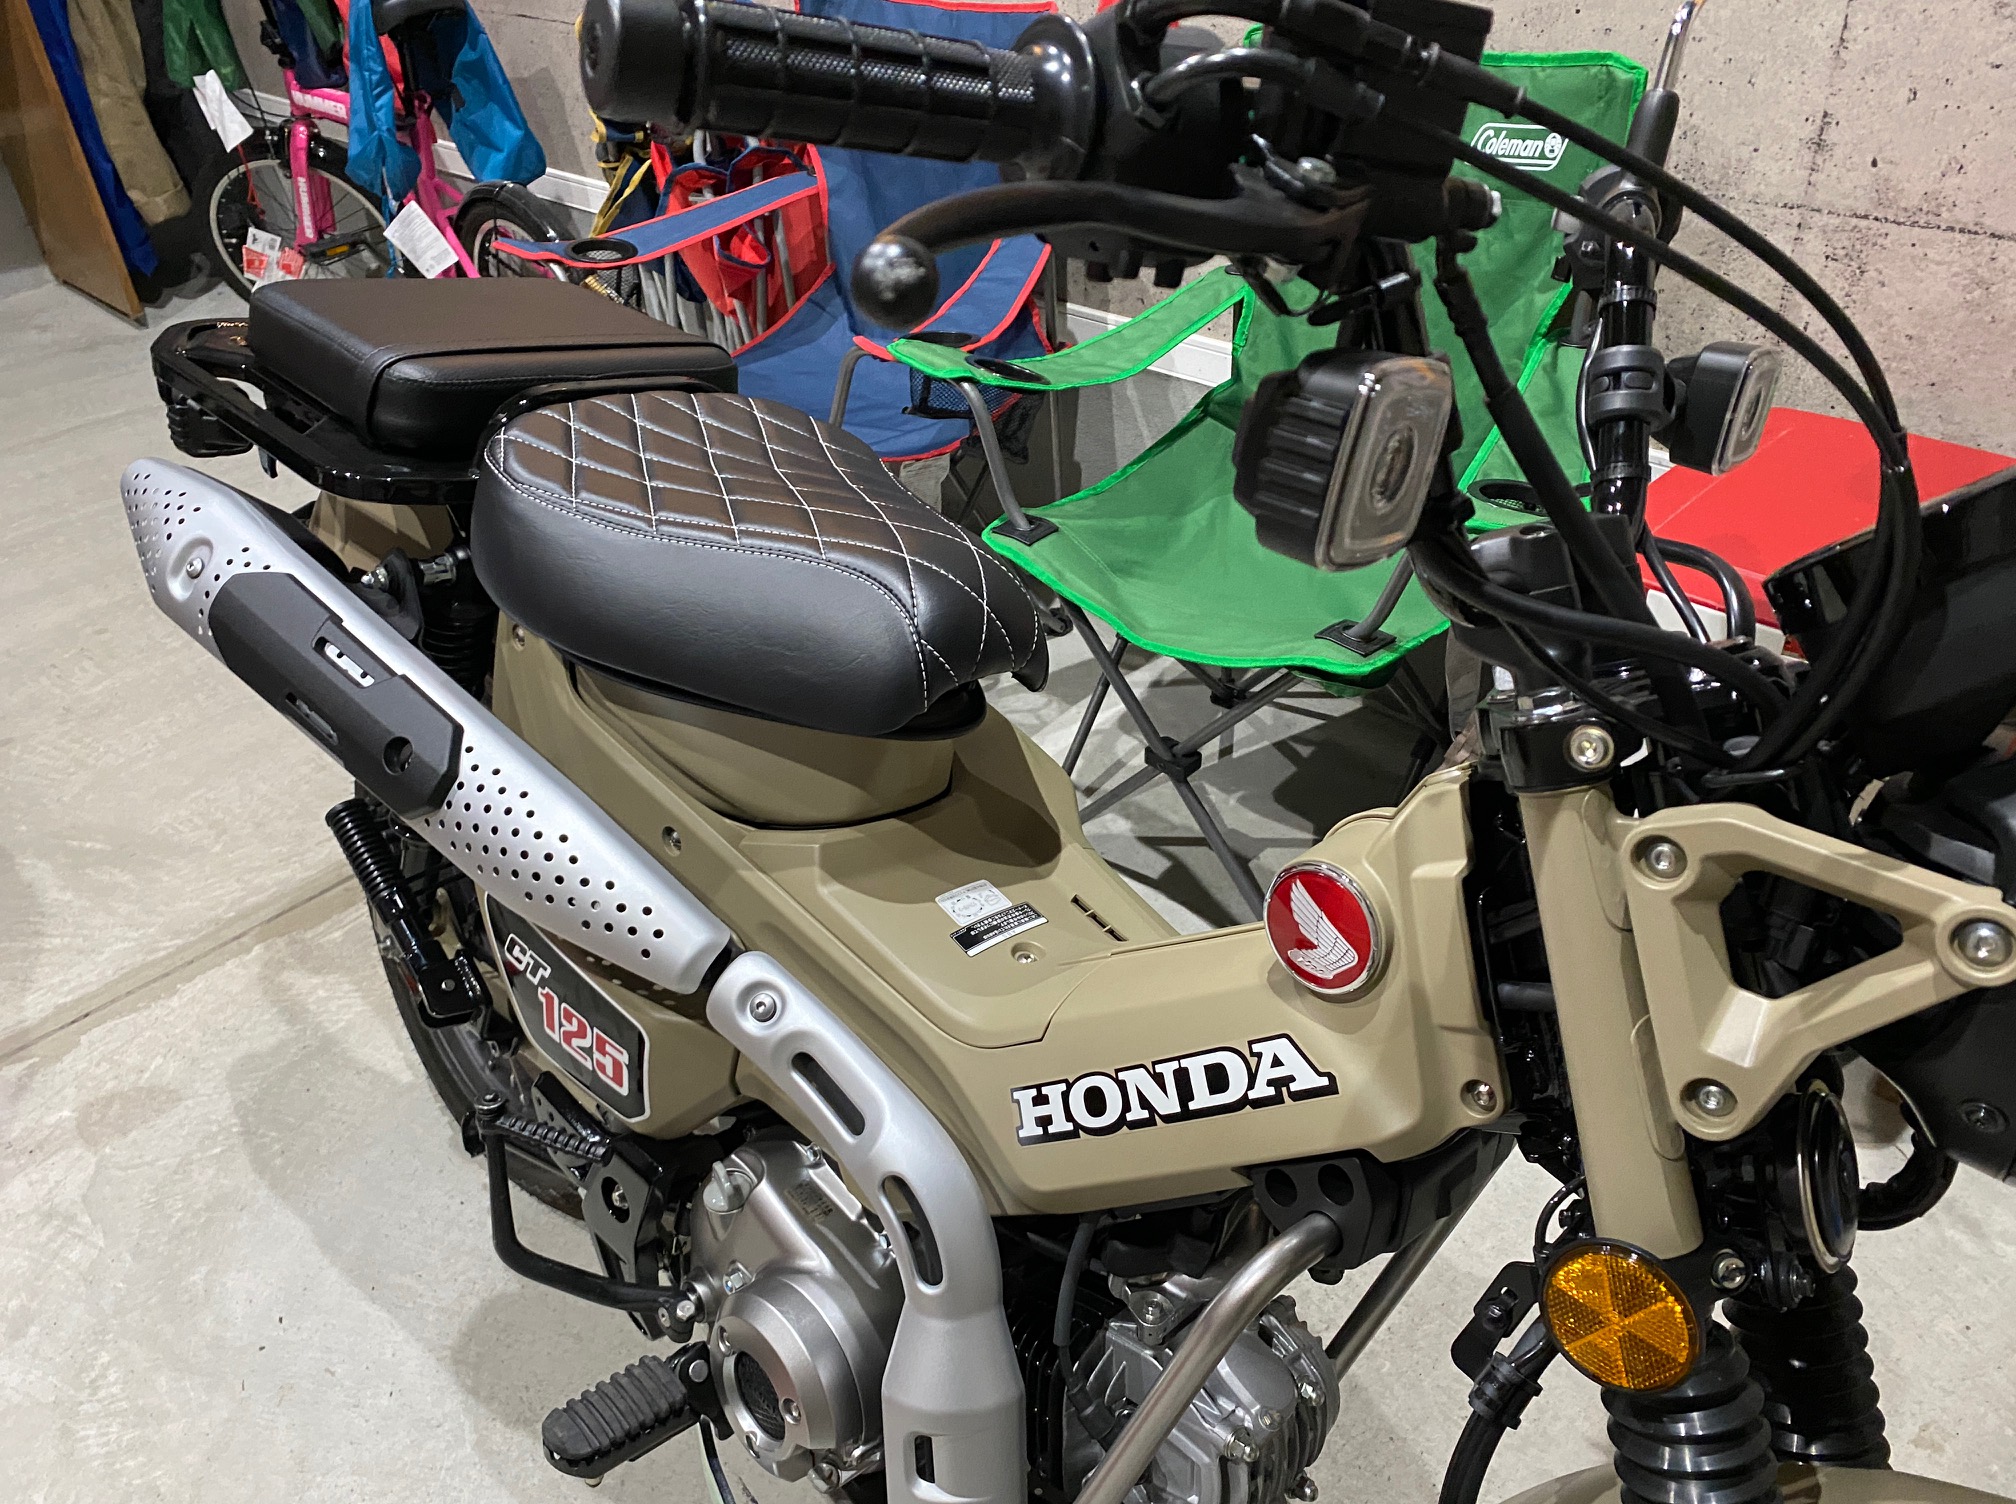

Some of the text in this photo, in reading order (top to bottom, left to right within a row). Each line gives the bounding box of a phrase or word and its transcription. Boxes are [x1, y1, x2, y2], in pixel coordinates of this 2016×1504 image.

[1477, 129, 1545, 157] Coleman
[504, 933, 551, 986] CT
[538, 985, 630, 1097] 125
[1012, 1035, 1335, 1143] HONDA
